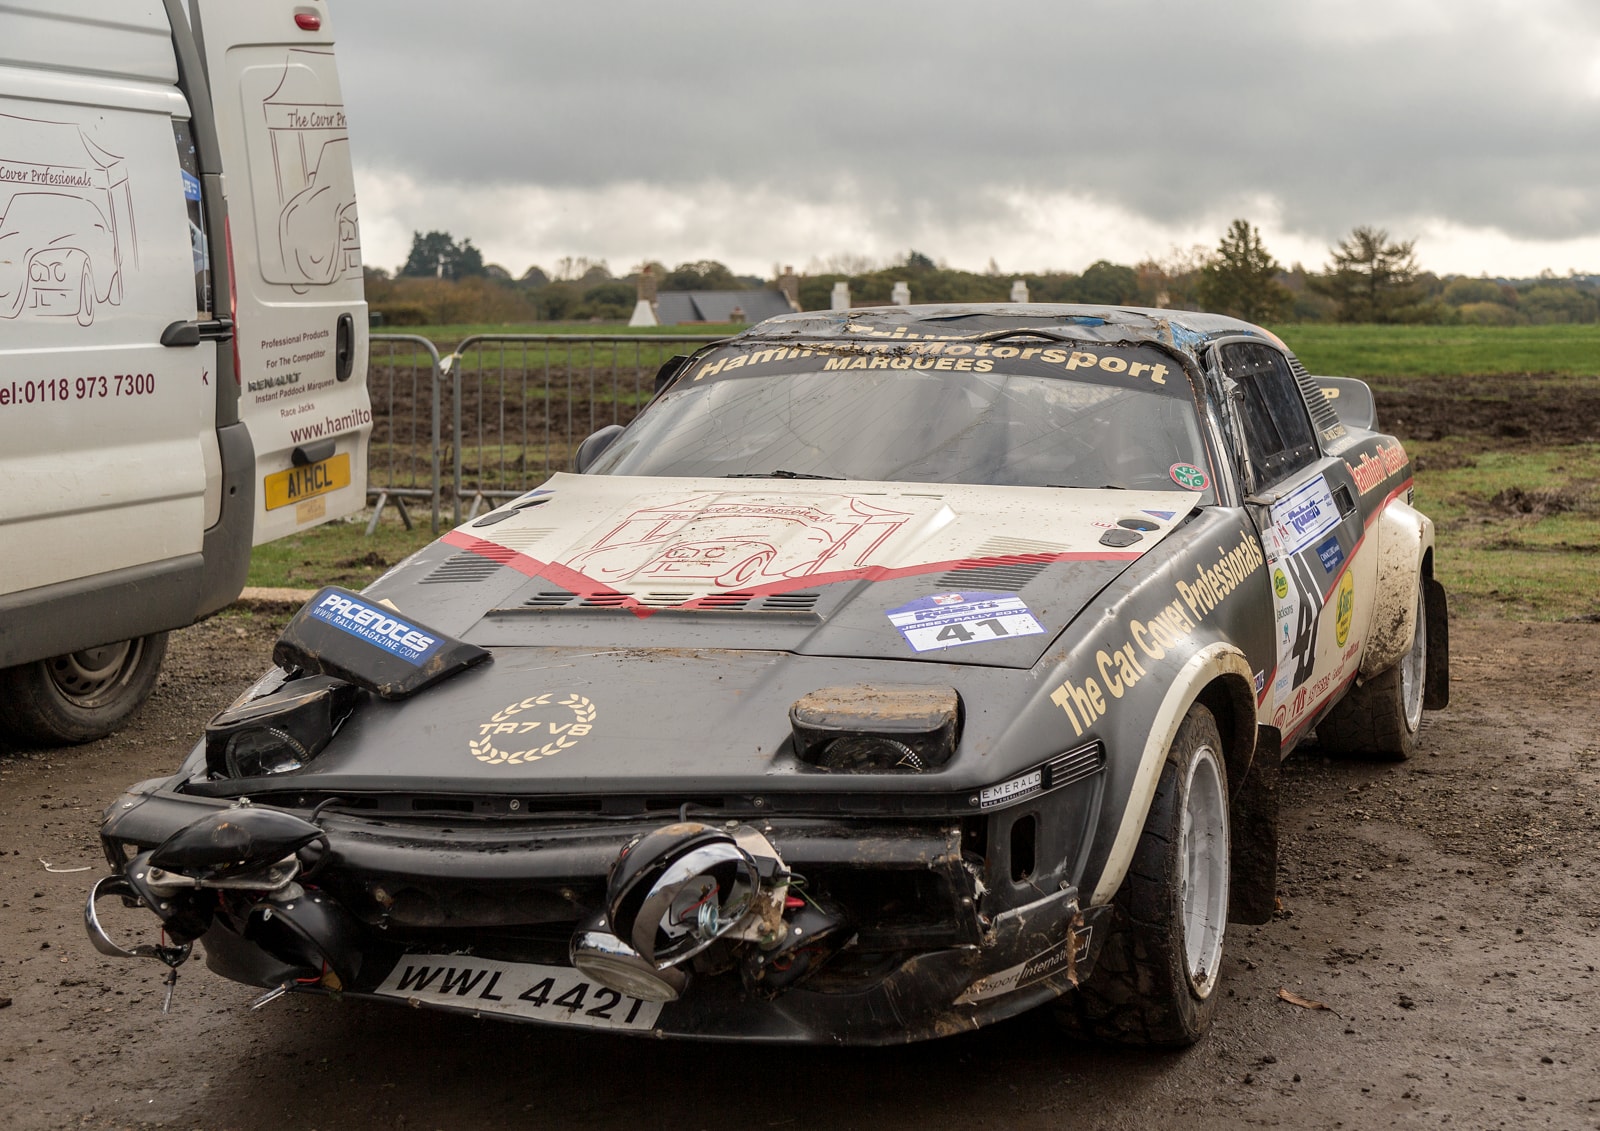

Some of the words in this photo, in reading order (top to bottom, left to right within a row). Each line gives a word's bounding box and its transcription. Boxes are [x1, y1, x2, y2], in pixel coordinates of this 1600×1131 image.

[288, 108, 309, 127] The
[0, 166, 28, 180] Cover
[31, 167, 92, 187] Professionals
[261, 334, 301, 349] Professional
[302, 330, 329, 342] Products
[266, 360, 278, 369] For
[279, 356, 291, 367] The
[292, 350, 326, 364] Competitor
[823, 355, 994, 373] MARQUEES
[901, 341, 1170, 385] Motorsport
[75, 376, 108, 399] 973
[114, 373, 155, 396] 7300
[248, 372, 302, 392] RENAULT
[255, 392, 278, 404] Instant
[279, 385, 305, 399] Paddock
[306, 378, 335, 391] Marquees
[280, 408, 297, 418] Race
[298, 403, 315, 414] Jacks
[304, 463, 333, 492] HCL
[901, 618, 950, 631] JERSEY
[953, 613, 992, 625] RALLY
[995, 609, 1028, 620] 2017
[936, 618, 1009, 642] 41
[313, 607, 420, 660] WWW.RALLYMAGAZINE.COM
[1050, 679, 1107, 737] The
[1096, 640, 1147, 699] Car
[1129, 597, 1196, 660] Cover
[1174, 530, 1264, 622] Professionals
[479, 721, 542, 735] TR7
[549, 722, 593, 736] V8
[982, 773, 1041, 799] EMERALD
[396, 966, 503, 1001] WWL
